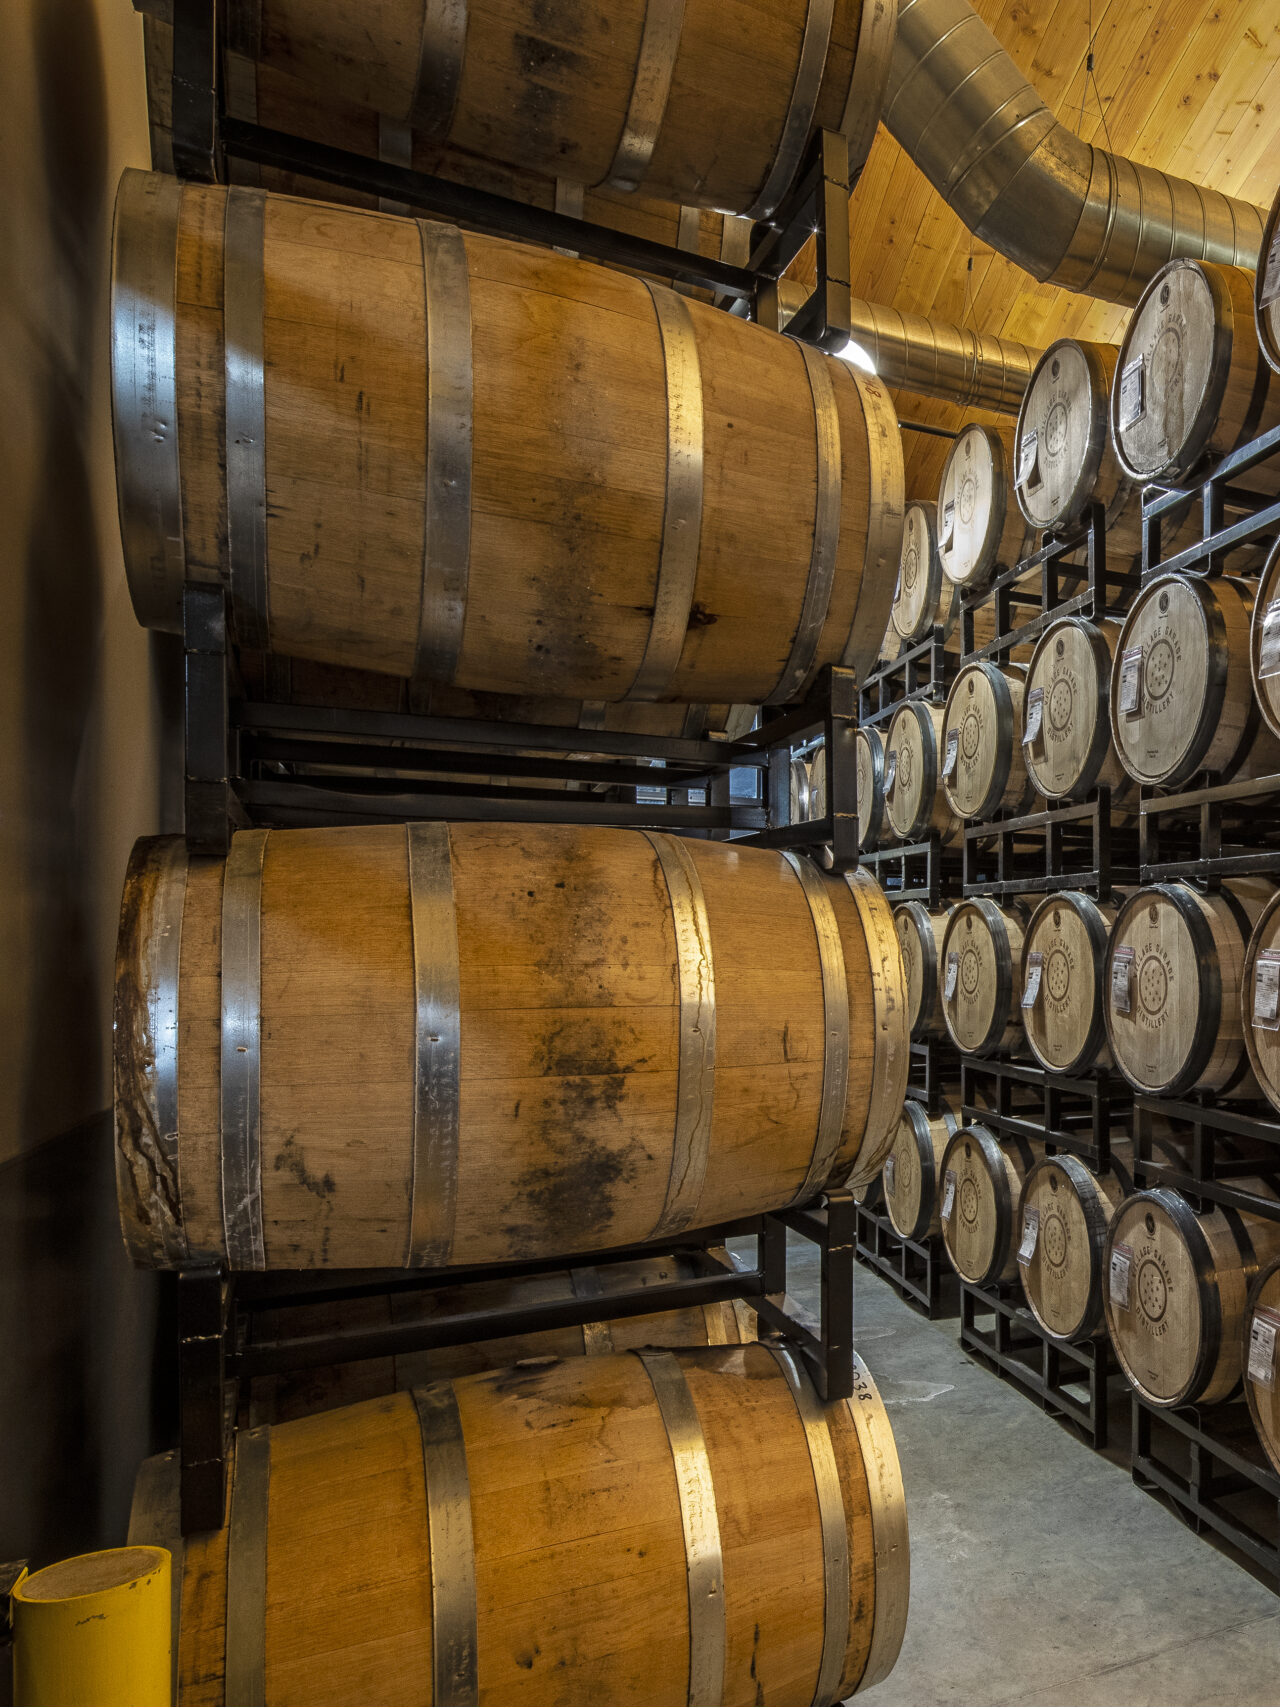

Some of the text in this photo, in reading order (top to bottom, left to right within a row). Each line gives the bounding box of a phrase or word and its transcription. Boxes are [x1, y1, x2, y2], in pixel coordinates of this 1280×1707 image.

[1165, 626, 1181, 662] GARAGE
[1044, 667, 1078, 706] VILLAGE GARAGE
[1046, 723, 1074, 743] DISTILLERY
[1059, 938, 1075, 971] GARAGE
[1133, 942, 1174, 982] VILLAGE GARAGE
[1043, 994, 1072, 1015] DISTILLERY
[1135, 1005, 1170, 1030] DISTILLERY
[1132, 1245, 1151, 1278] VILLAGE
[1153, 1248, 1174, 1293] GARAGE
[1135, 1306, 1169, 1337] DISTILLERY
